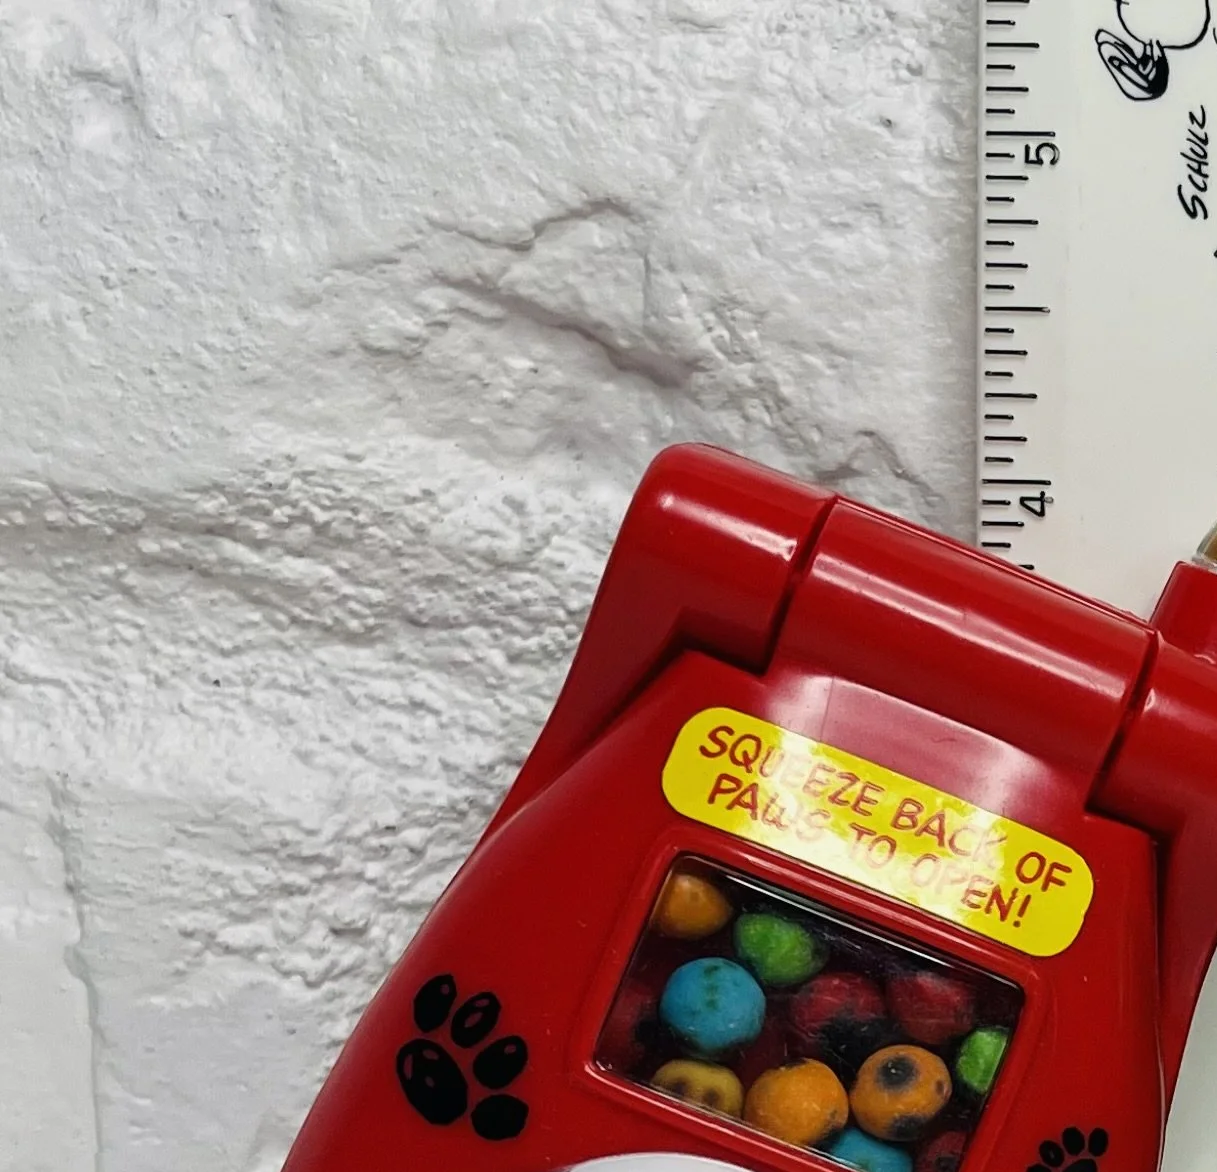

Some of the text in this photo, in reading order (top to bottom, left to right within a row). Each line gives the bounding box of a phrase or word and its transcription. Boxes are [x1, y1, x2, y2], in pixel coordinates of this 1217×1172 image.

[1024, 142, 1060, 167] 5
[1178, 104, 1210, 220] SCHULZ
[1019, 490, 1053, 518] 4
[699, 725, 1073, 893] SQUEEZE BACK OF
[707, 773, 1033, 928] PAWS TO OPEN!
